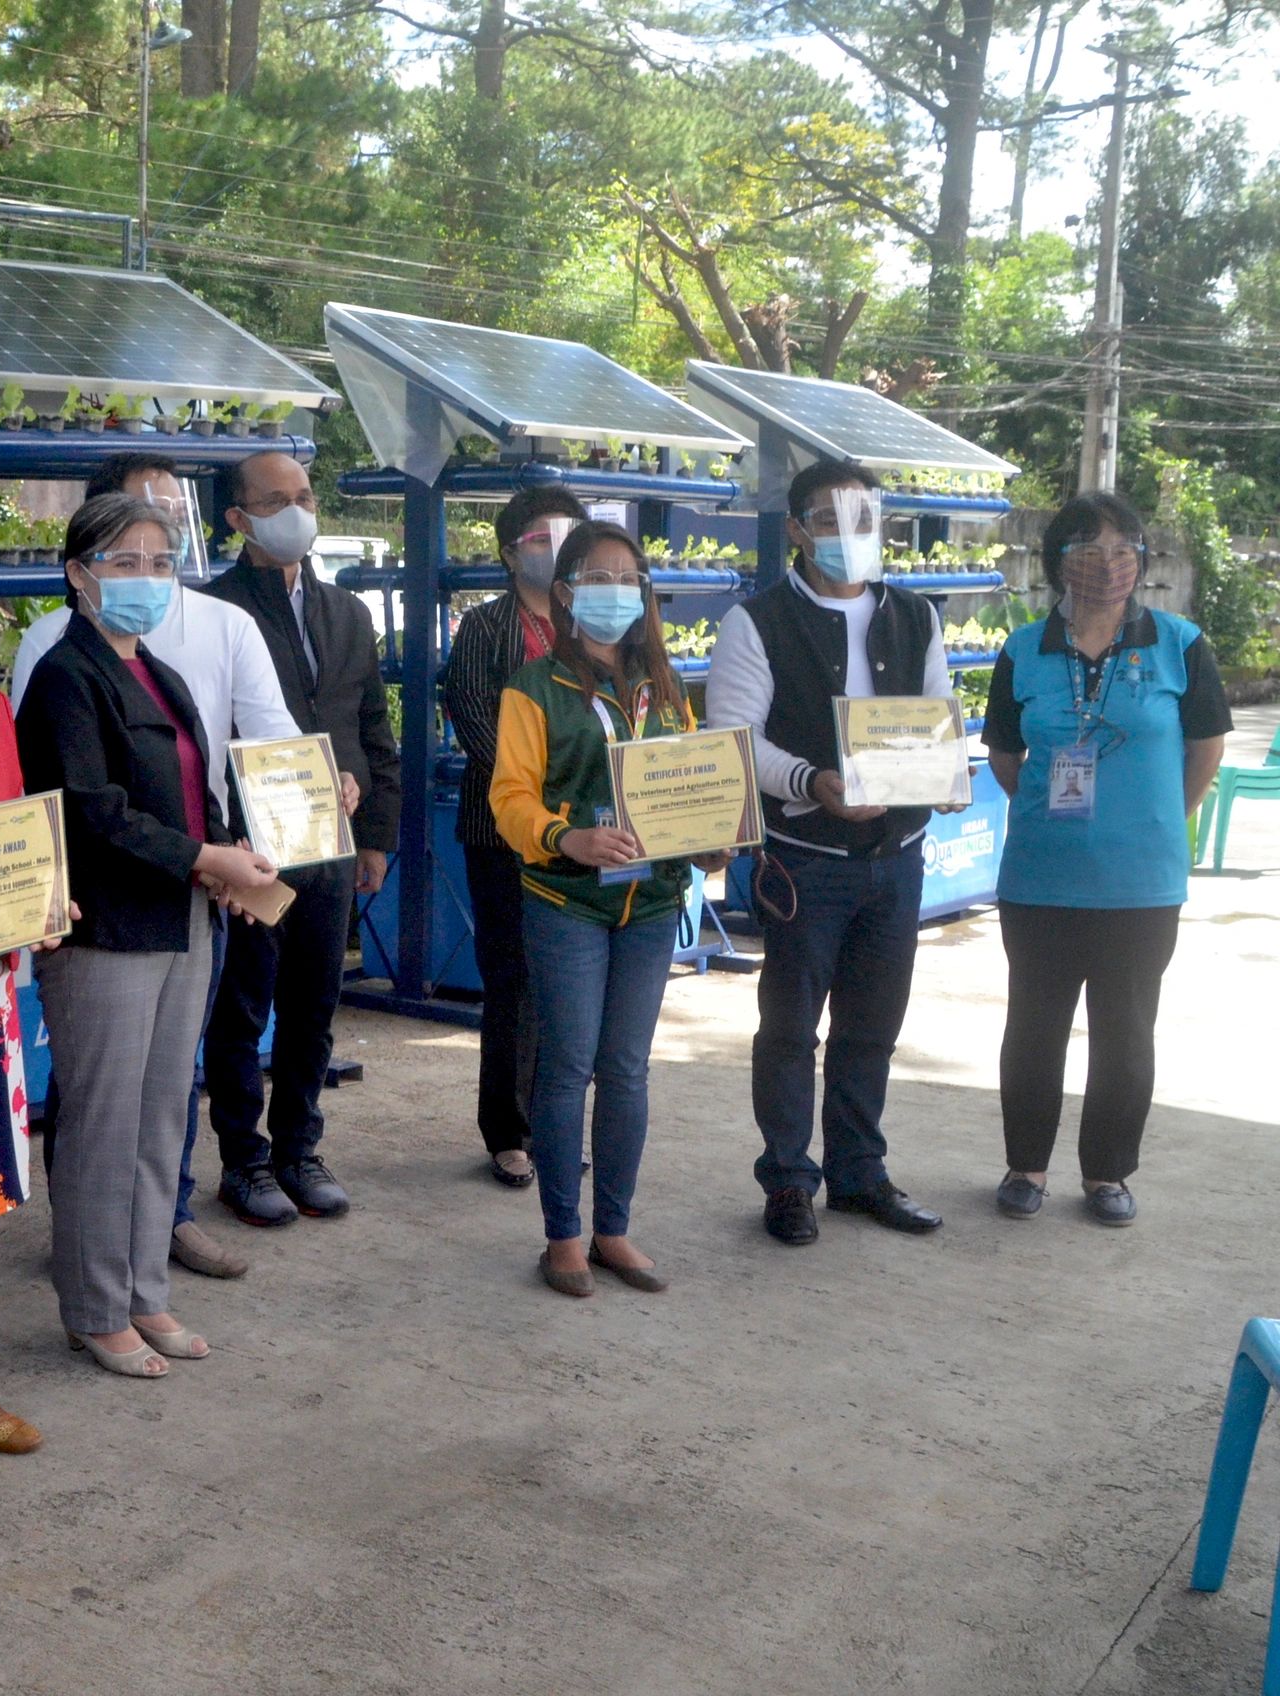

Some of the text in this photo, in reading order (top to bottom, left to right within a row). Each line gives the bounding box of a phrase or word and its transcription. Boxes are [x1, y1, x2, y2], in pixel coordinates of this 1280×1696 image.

[644, 763, 717, 781] CERTIFICATE OF AWARD
[640, 786, 672, 797] Veterinary
[673, 784, 685, 792] and
[686, 780, 720, 793] Agriculture
[721, 777, 740, 785] Office
[961, 818, 988, 836] URBAN
[3, 839, 27, 855] AWARD
[11, 859, 32, 871] School
[36, 855, 51, 865] Main
